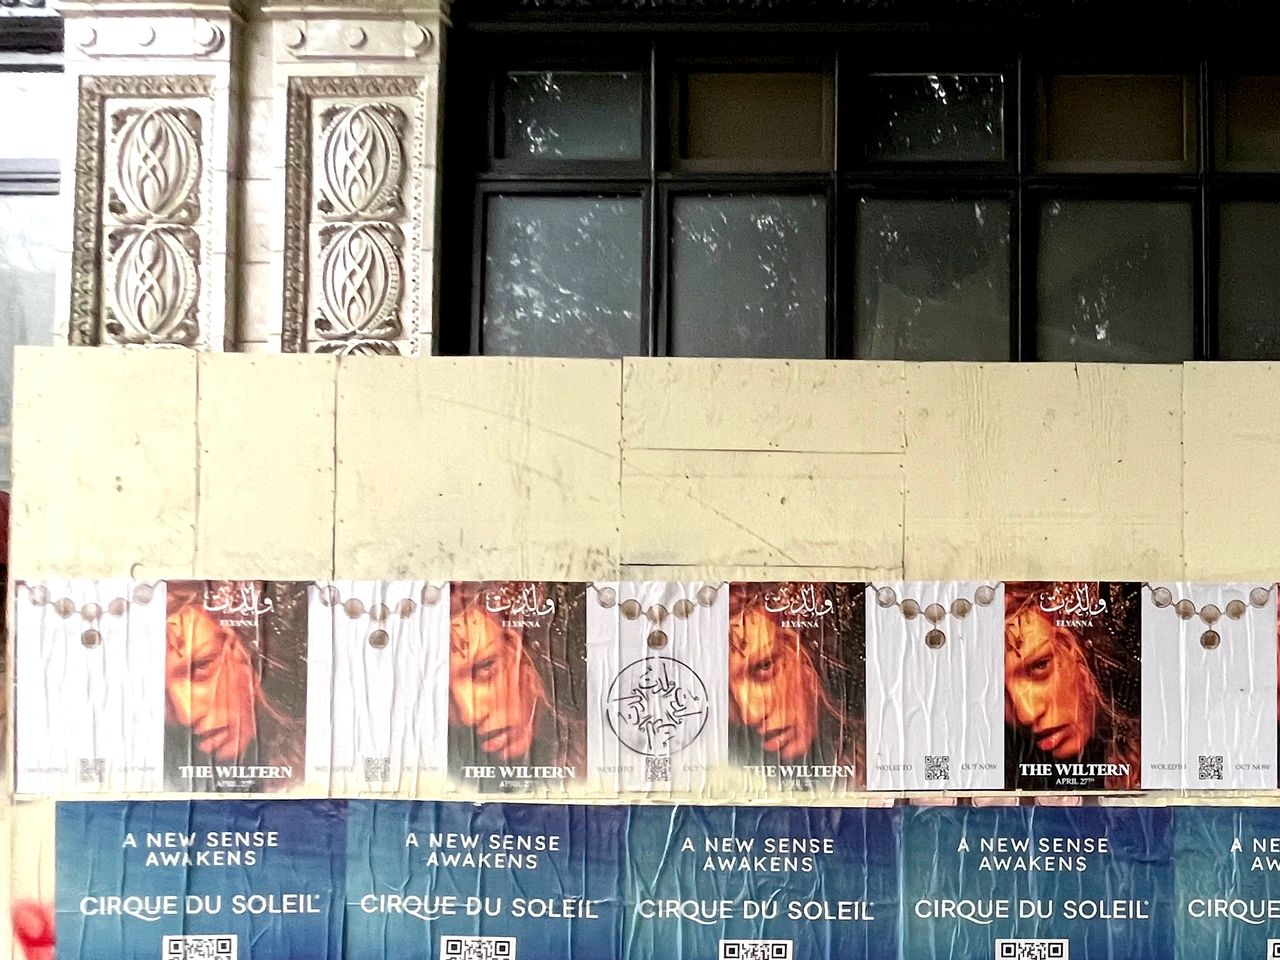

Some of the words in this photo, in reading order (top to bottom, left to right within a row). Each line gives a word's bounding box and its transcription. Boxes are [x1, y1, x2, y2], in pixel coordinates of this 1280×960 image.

[179, 766, 212, 778] THE
[215, 766, 293, 778] WILTERN
[462, 766, 495, 778] THE
[499, 766, 576, 778] WILTERN
[744, 765, 776, 777] THE
[779, 765, 855, 777] WILTERN
[1019, 764, 1052, 776] THE
[1055, 764, 1130, 776] WILTERN
[1056, 777, 1078, 786] APRIL
[123, 833, 137, 847] A
[147, 832, 196, 847] NEW
[207, 832, 278, 847] SENSE
[406, 833, 418, 847] A
[430, 834, 479, 849] NEW
[489, 835, 559, 851] SENSE
[681, 838, 695, 852] A
[706, 838, 754, 852] NEW
[764, 839, 834, 853] SENSE
[958, 837, 969, 852] A
[981, 838, 1030, 852] NEW
[1039, 838, 1108, 852] SENSE
[1231, 839, 1242, 852] A
[146, 851, 256, 866] AWAKENS
[427, 852, 537, 869] AWAKENS
[703, 857, 813, 872] AWAKENS
[979, 857, 1087, 871] AWAKENS
[80, 895, 177, 921] CIRQUE
[186, 895, 221, 914] DU
[232, 894, 320, 914] SOLEIL
[361, 894, 456, 920] CIRQUE
[467, 898, 501, 916] DU
[512, 899, 598, 919] SOLEIL
[638, 900, 733, 924] CIRQUE
[744, 901, 777, 919] DU
[788, 901, 874, 920] SOLEIL
[915, 900, 1009, 924] CIRQUE
[1020, 900, 1053, 918] DU
[1063, 901, 1148, 919] SOLEIL
[1188, 900, 1280, 924] CIRQUE
